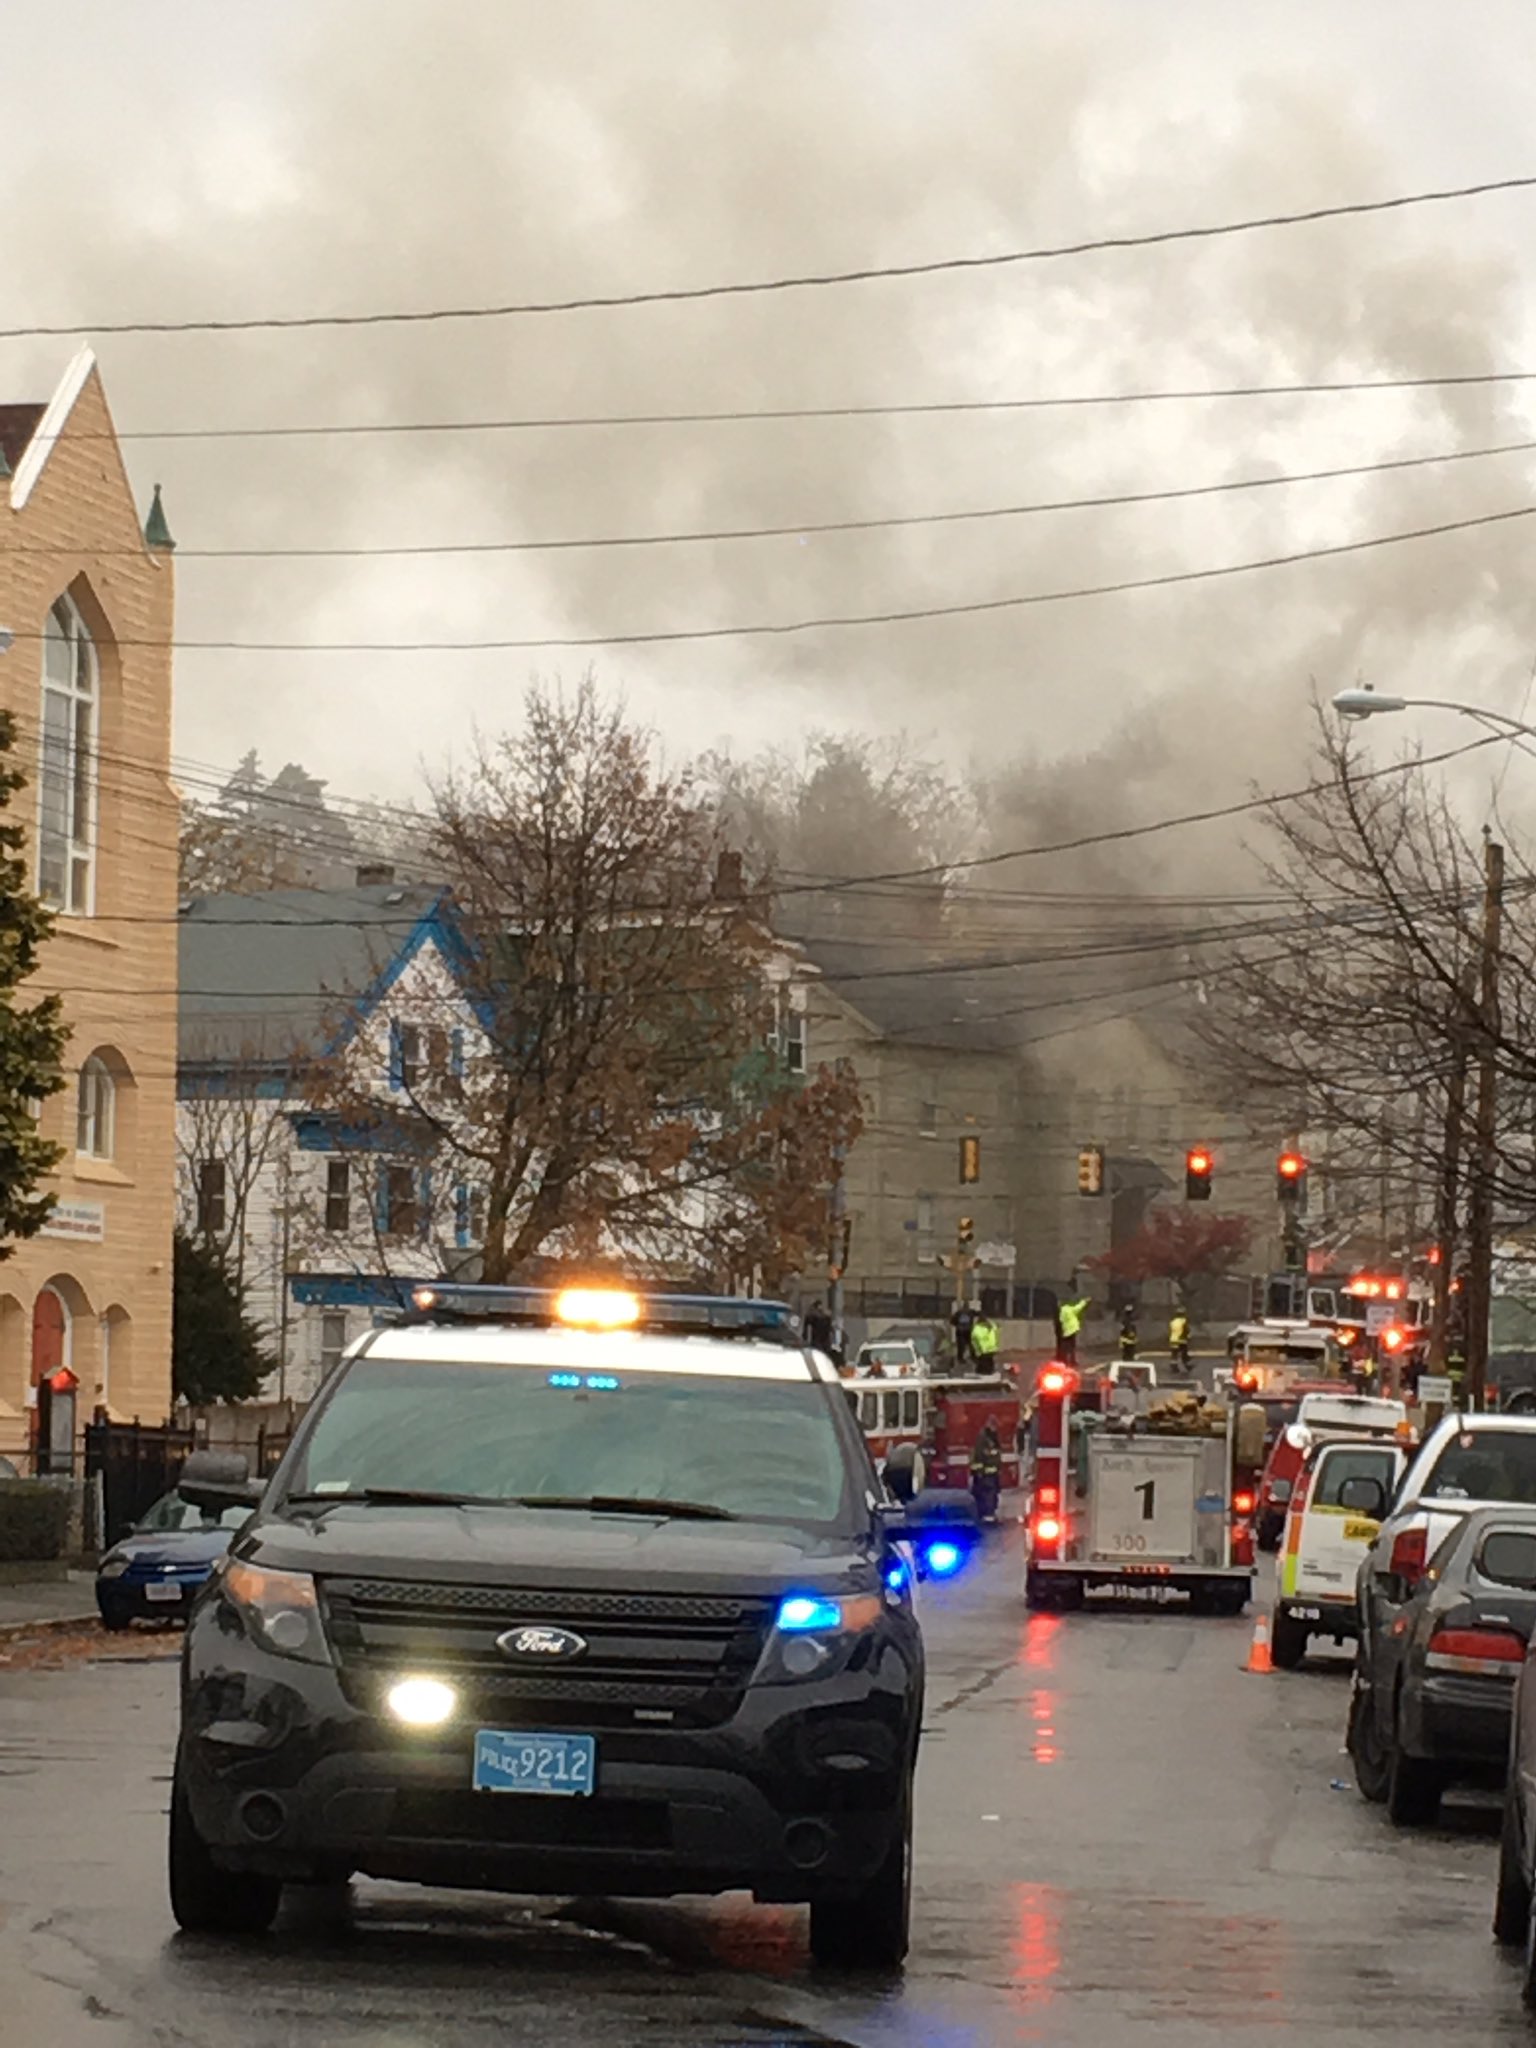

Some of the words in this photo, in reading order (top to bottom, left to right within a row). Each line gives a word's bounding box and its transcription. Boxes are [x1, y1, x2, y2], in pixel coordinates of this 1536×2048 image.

[1133, 1480, 1155, 1520] 1
[1112, 1534, 1146, 1552] 300
[515, 1630, 566, 1653] Ford
[480, 1746, 519, 1778] POLICE
[520, 1747, 588, 1781] 9212
